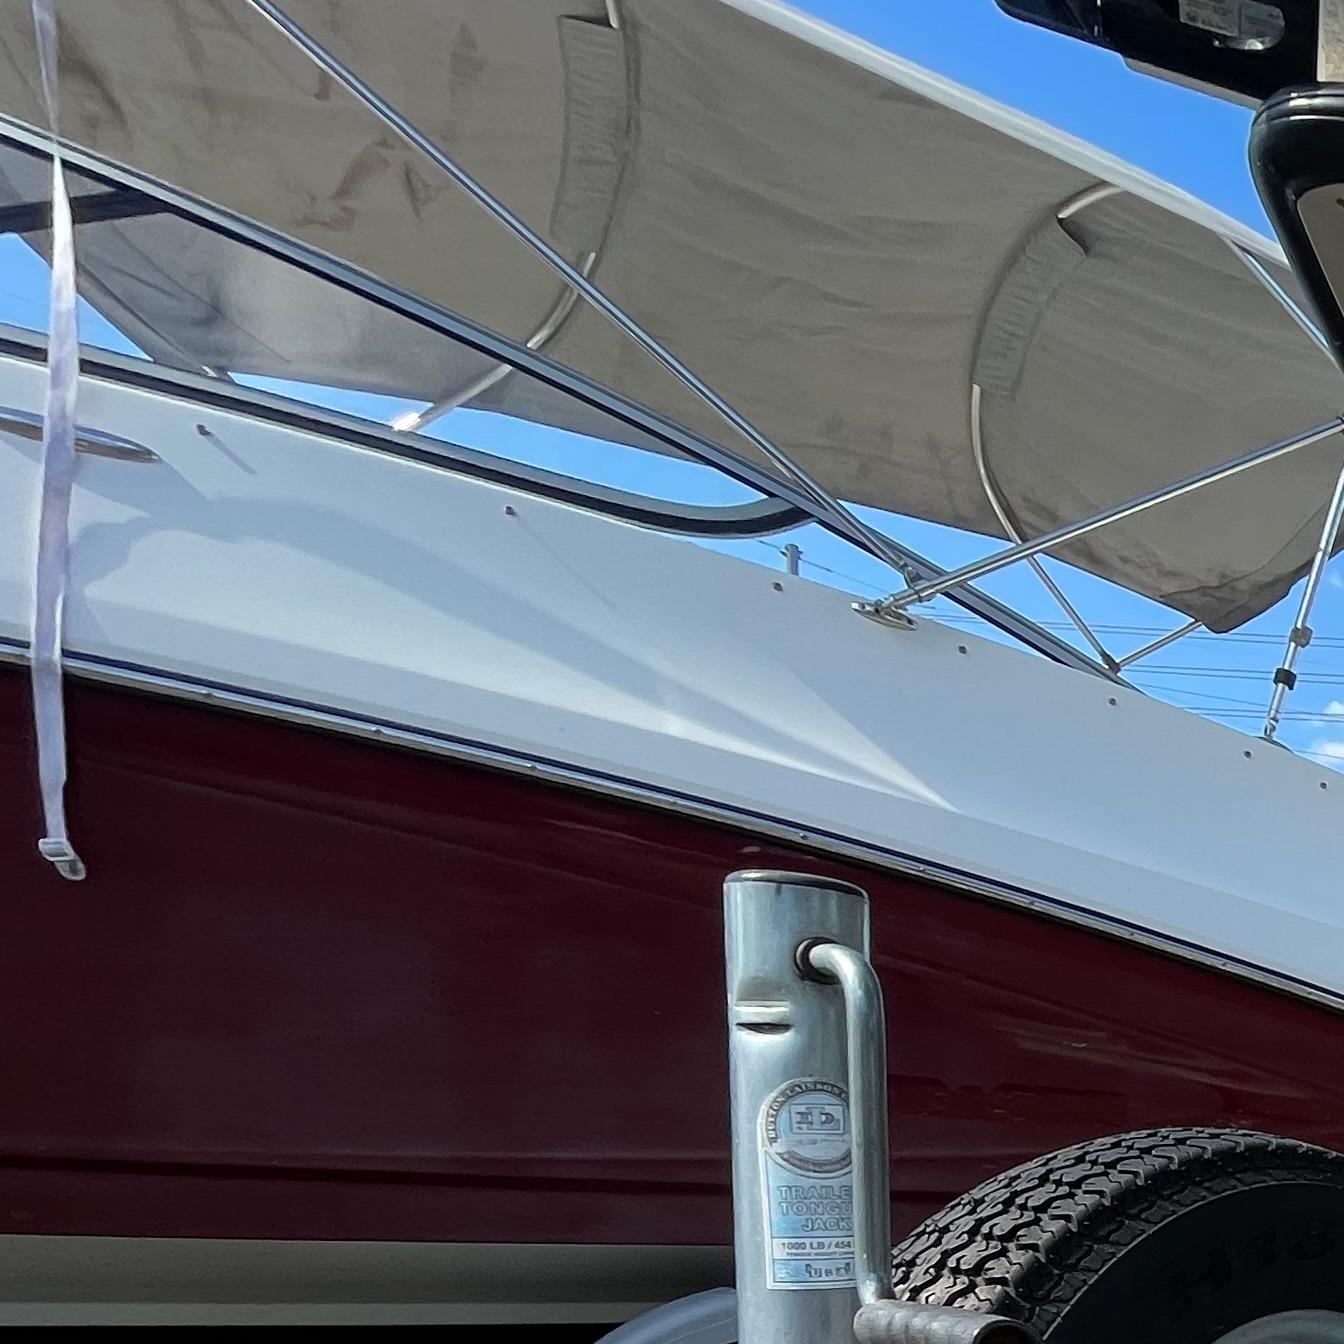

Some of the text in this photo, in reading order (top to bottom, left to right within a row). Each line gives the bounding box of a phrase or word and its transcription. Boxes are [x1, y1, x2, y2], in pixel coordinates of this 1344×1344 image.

[777, 1185, 853, 1200] TRAILE
[778, 1200, 853, 1216] TONGU
[801, 1216, 852, 1232] JACK
